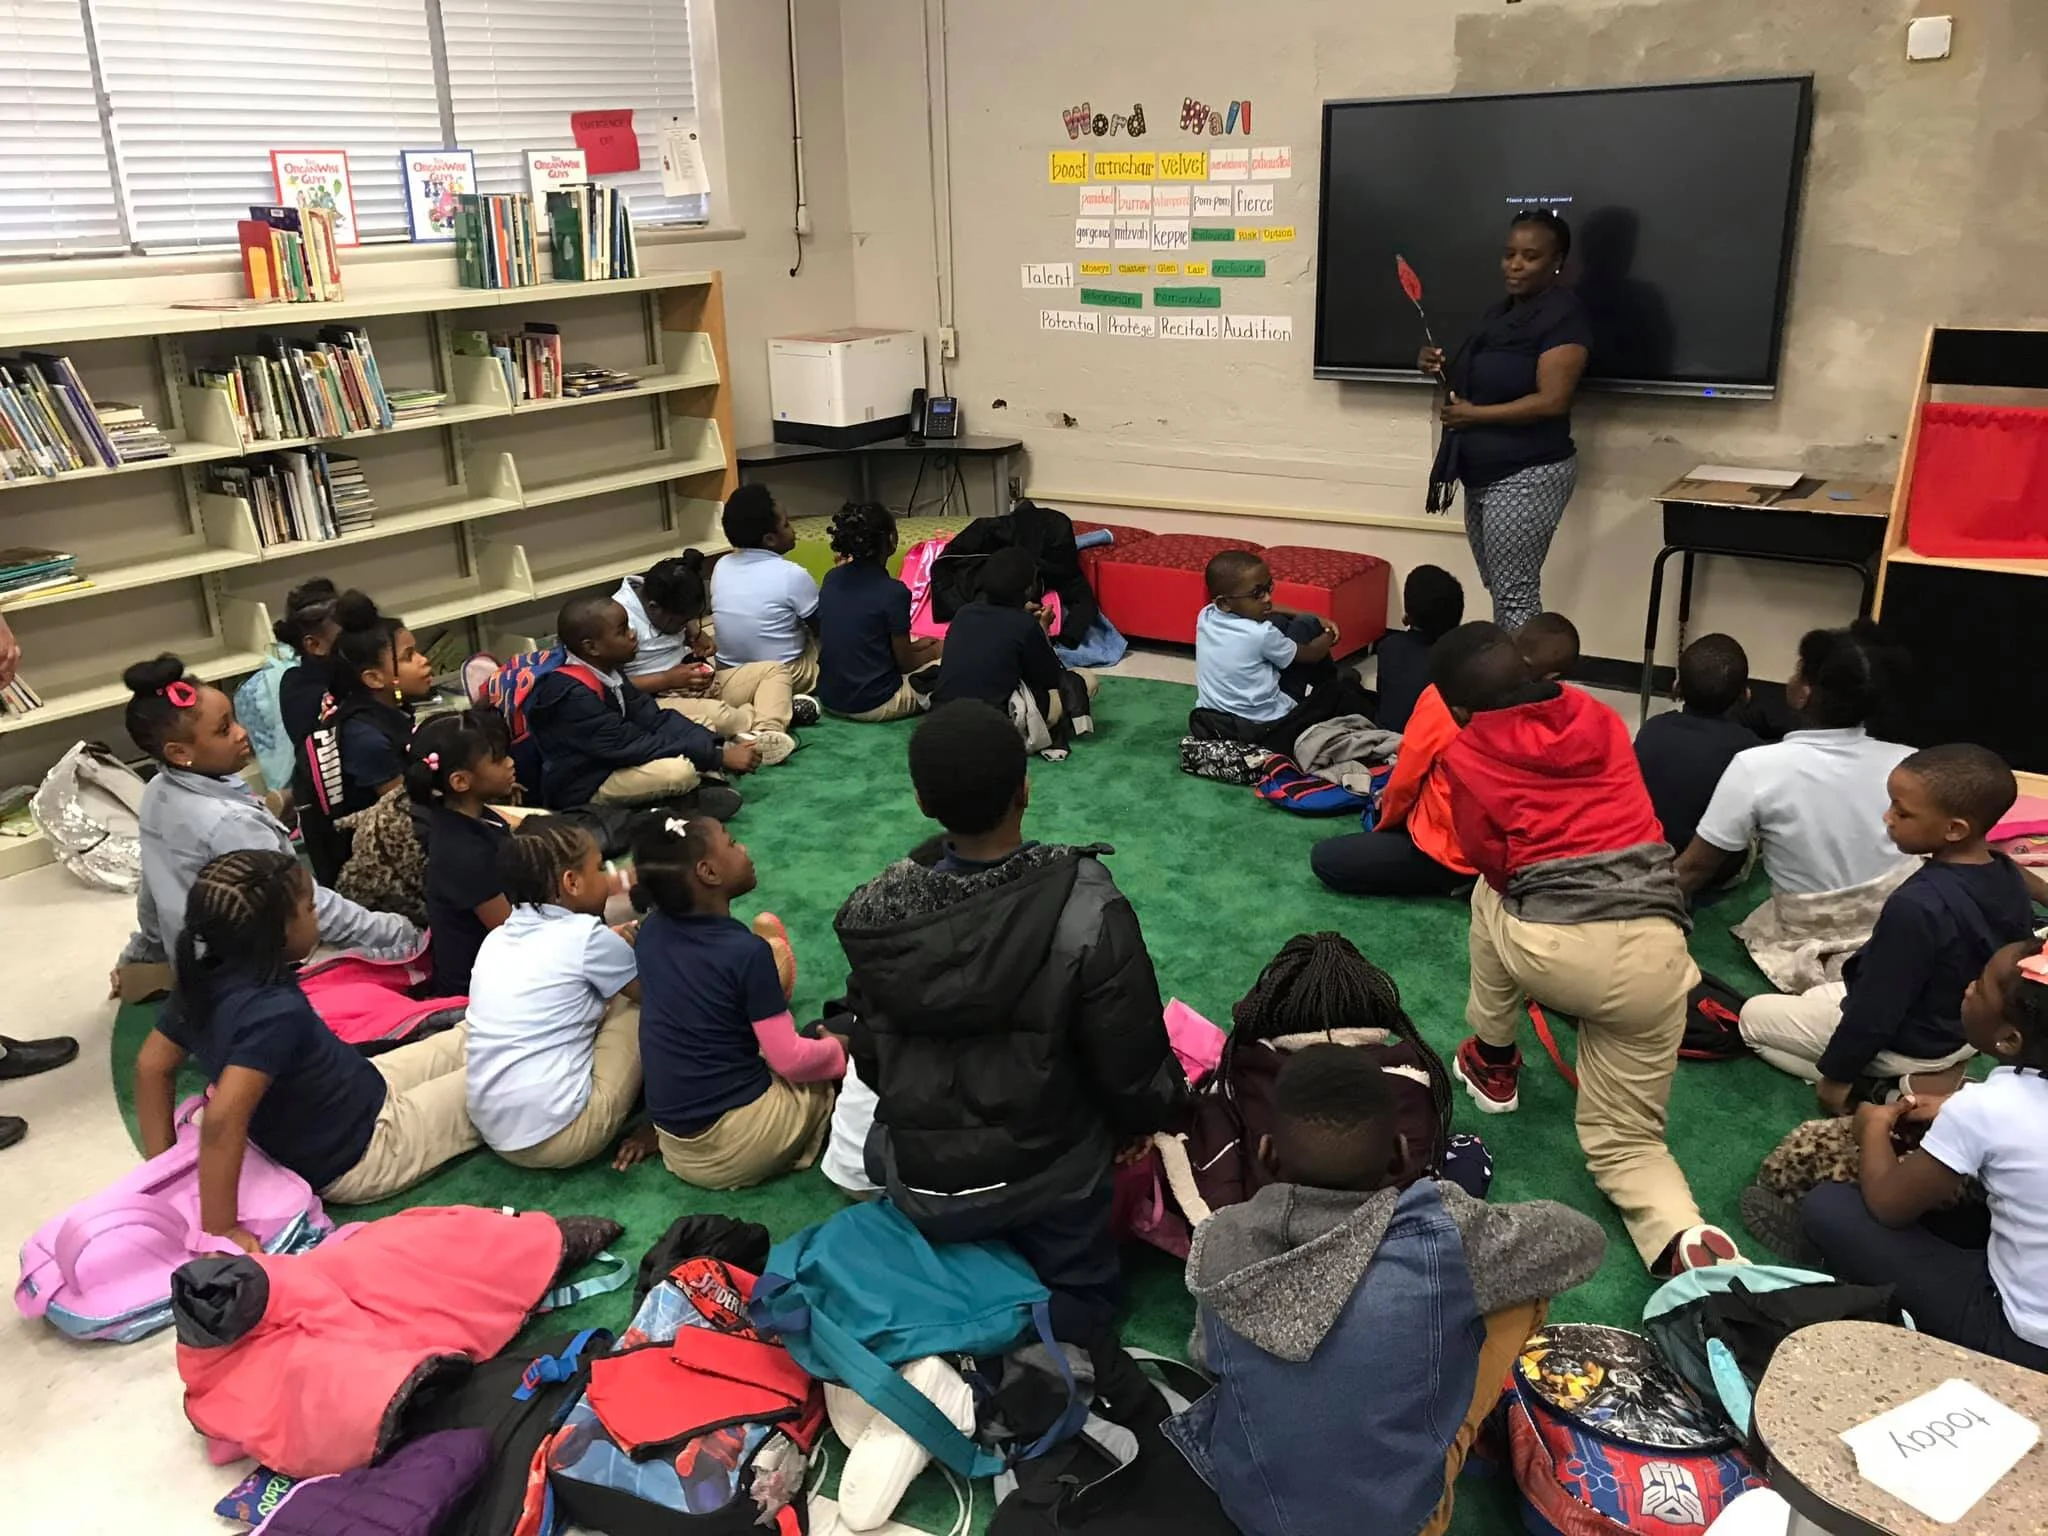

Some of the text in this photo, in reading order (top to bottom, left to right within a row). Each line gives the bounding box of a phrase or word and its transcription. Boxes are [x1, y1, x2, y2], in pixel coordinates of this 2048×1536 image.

[1062, 97, 1252, 140] Word Wall
[1052, 153, 1087, 180] boost
[1095, 154, 1154, 176] armchair
[1161, 152, 1206, 175] velvet
[1237, 189, 1273, 211] fierce
[1076, 227, 1110, 244] gorgeous
[1264, 229, 1293, 239] Option
[1023, 265, 1072, 286] Talent
[1157, 264, 1176, 273] Glen
[1188, 265, 1205, 274] Lair
[1042, 311, 1100, 334] Potential
[1161, 317, 1218, 337] Recitals
[1223, 316, 1291, 341] Audition
[1888, 1407, 1991, 1459] today
